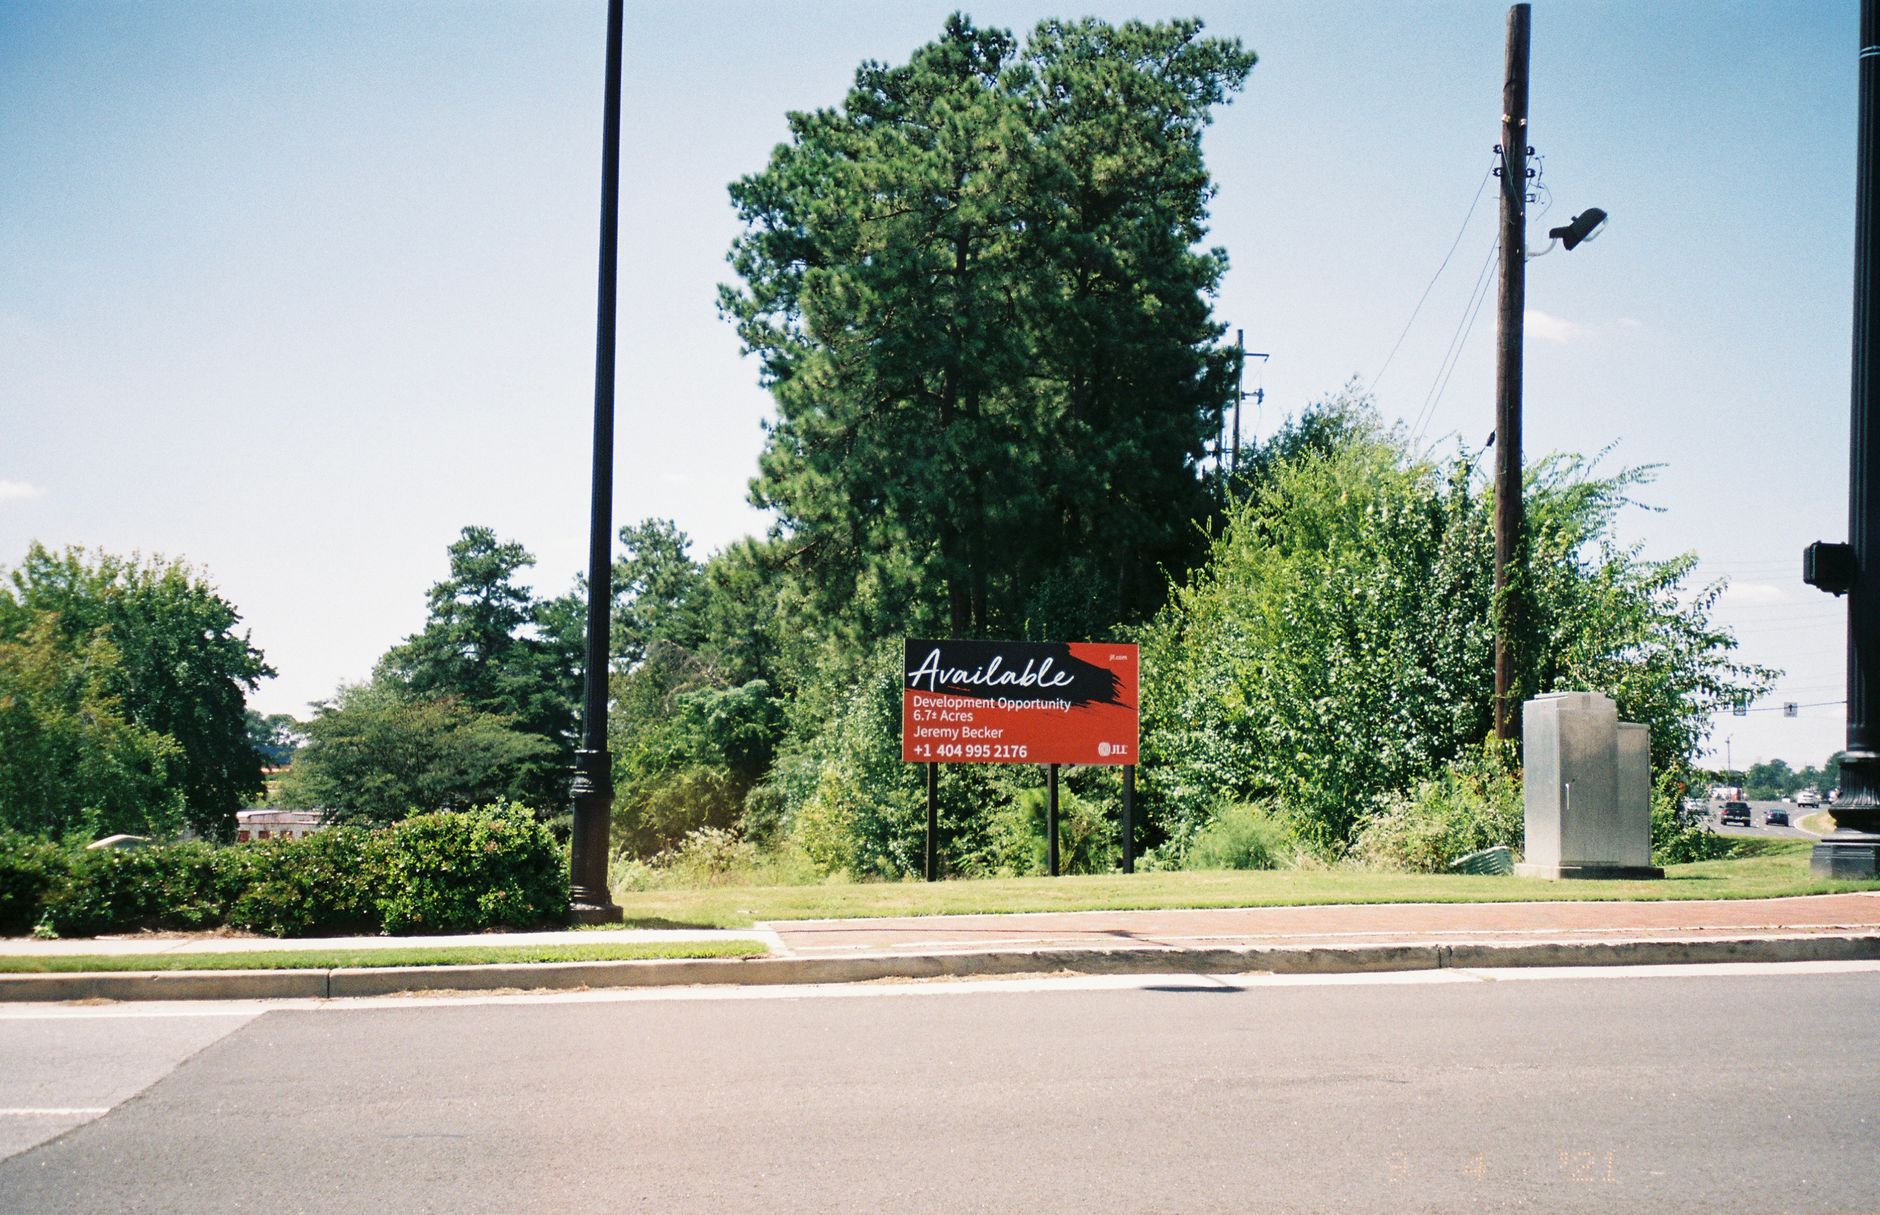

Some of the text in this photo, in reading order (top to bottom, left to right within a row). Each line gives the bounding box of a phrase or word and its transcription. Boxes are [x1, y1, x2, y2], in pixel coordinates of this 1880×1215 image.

[1109, 653, 1128, 661] jll.com
[908, 648, 1074, 692] Available
[913, 695, 1071, 712] Development Opportunity
[940, 710, 974, 721] Acres
[913, 725, 1003, 741] Jeremy Becker
[914, 744, 1028, 758] +1 404 995 2176
[1110, 744, 1128, 755] JLL
